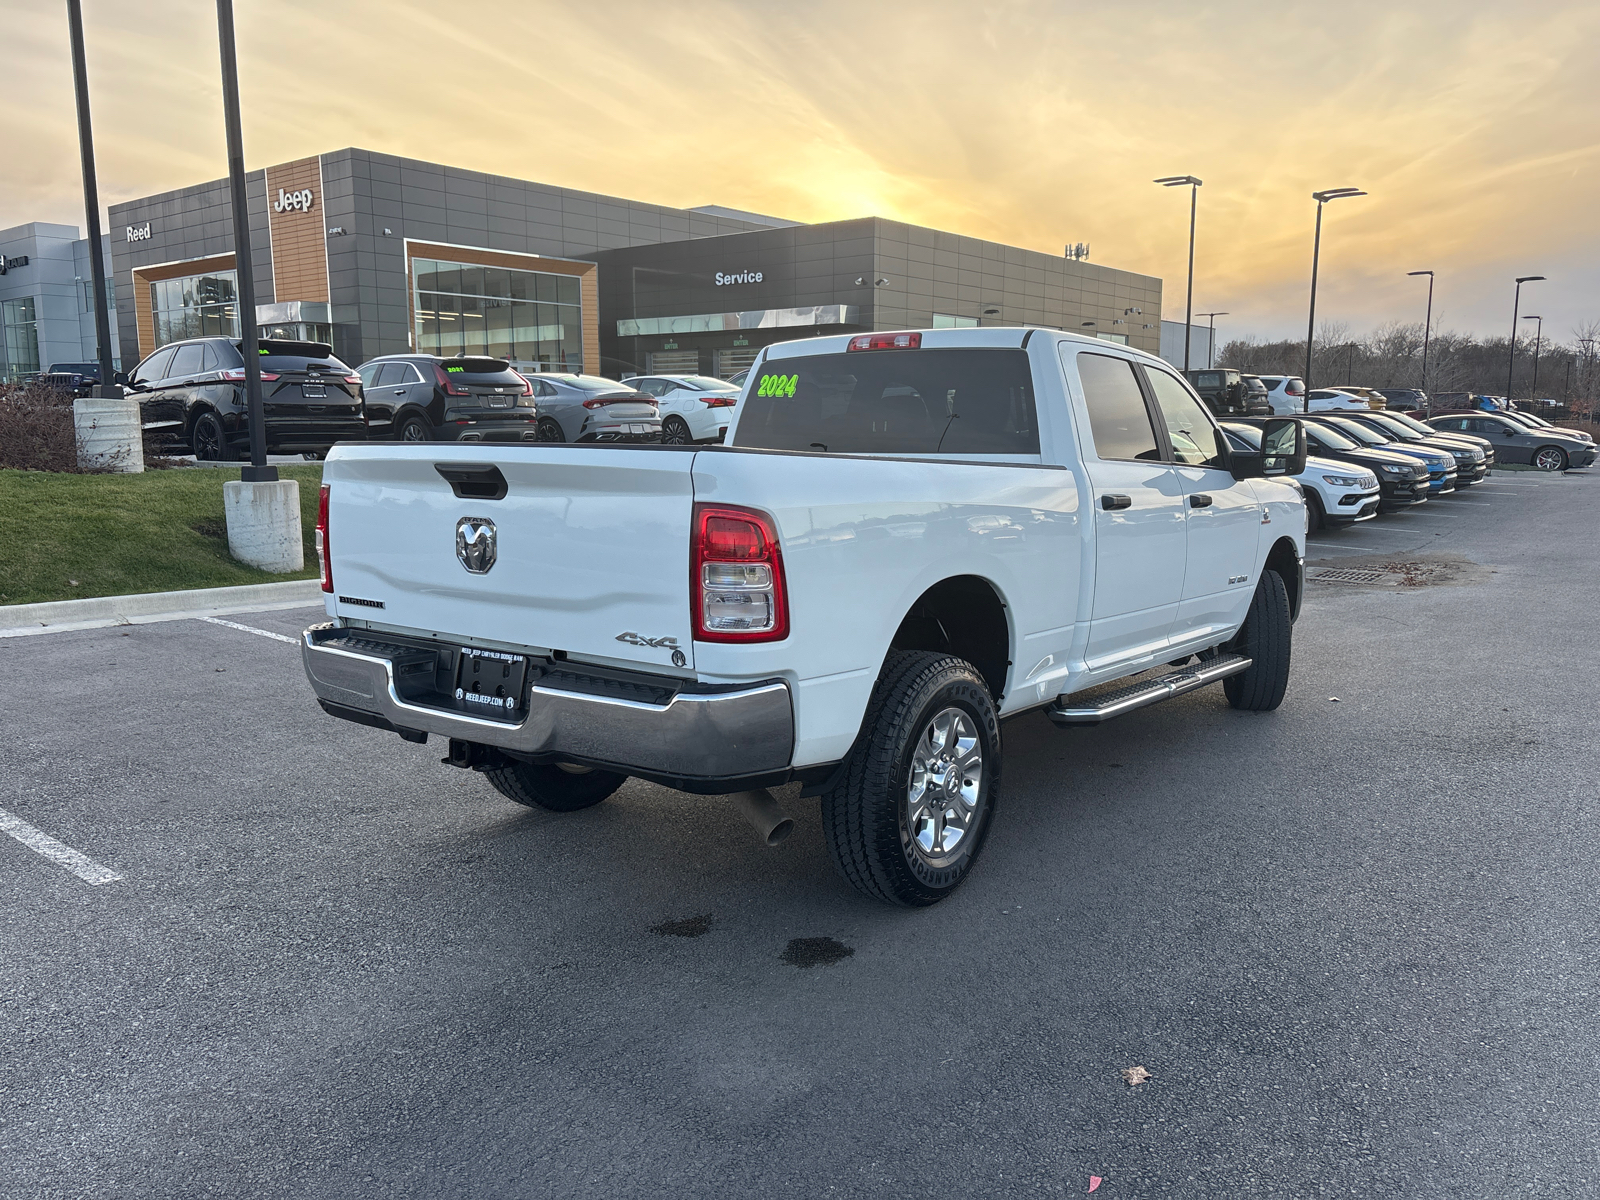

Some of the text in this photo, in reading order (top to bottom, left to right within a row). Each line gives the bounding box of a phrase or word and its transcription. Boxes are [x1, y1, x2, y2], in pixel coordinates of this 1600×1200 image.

[274, 188, 313, 213] Jeep
[126, 222, 151, 242] Reed
[715, 269, 763, 286] Service
[664, 342, 679, 350] ENTER
[733, 339, 749, 347] ENTER
[757, 374, 799, 398] 2024
